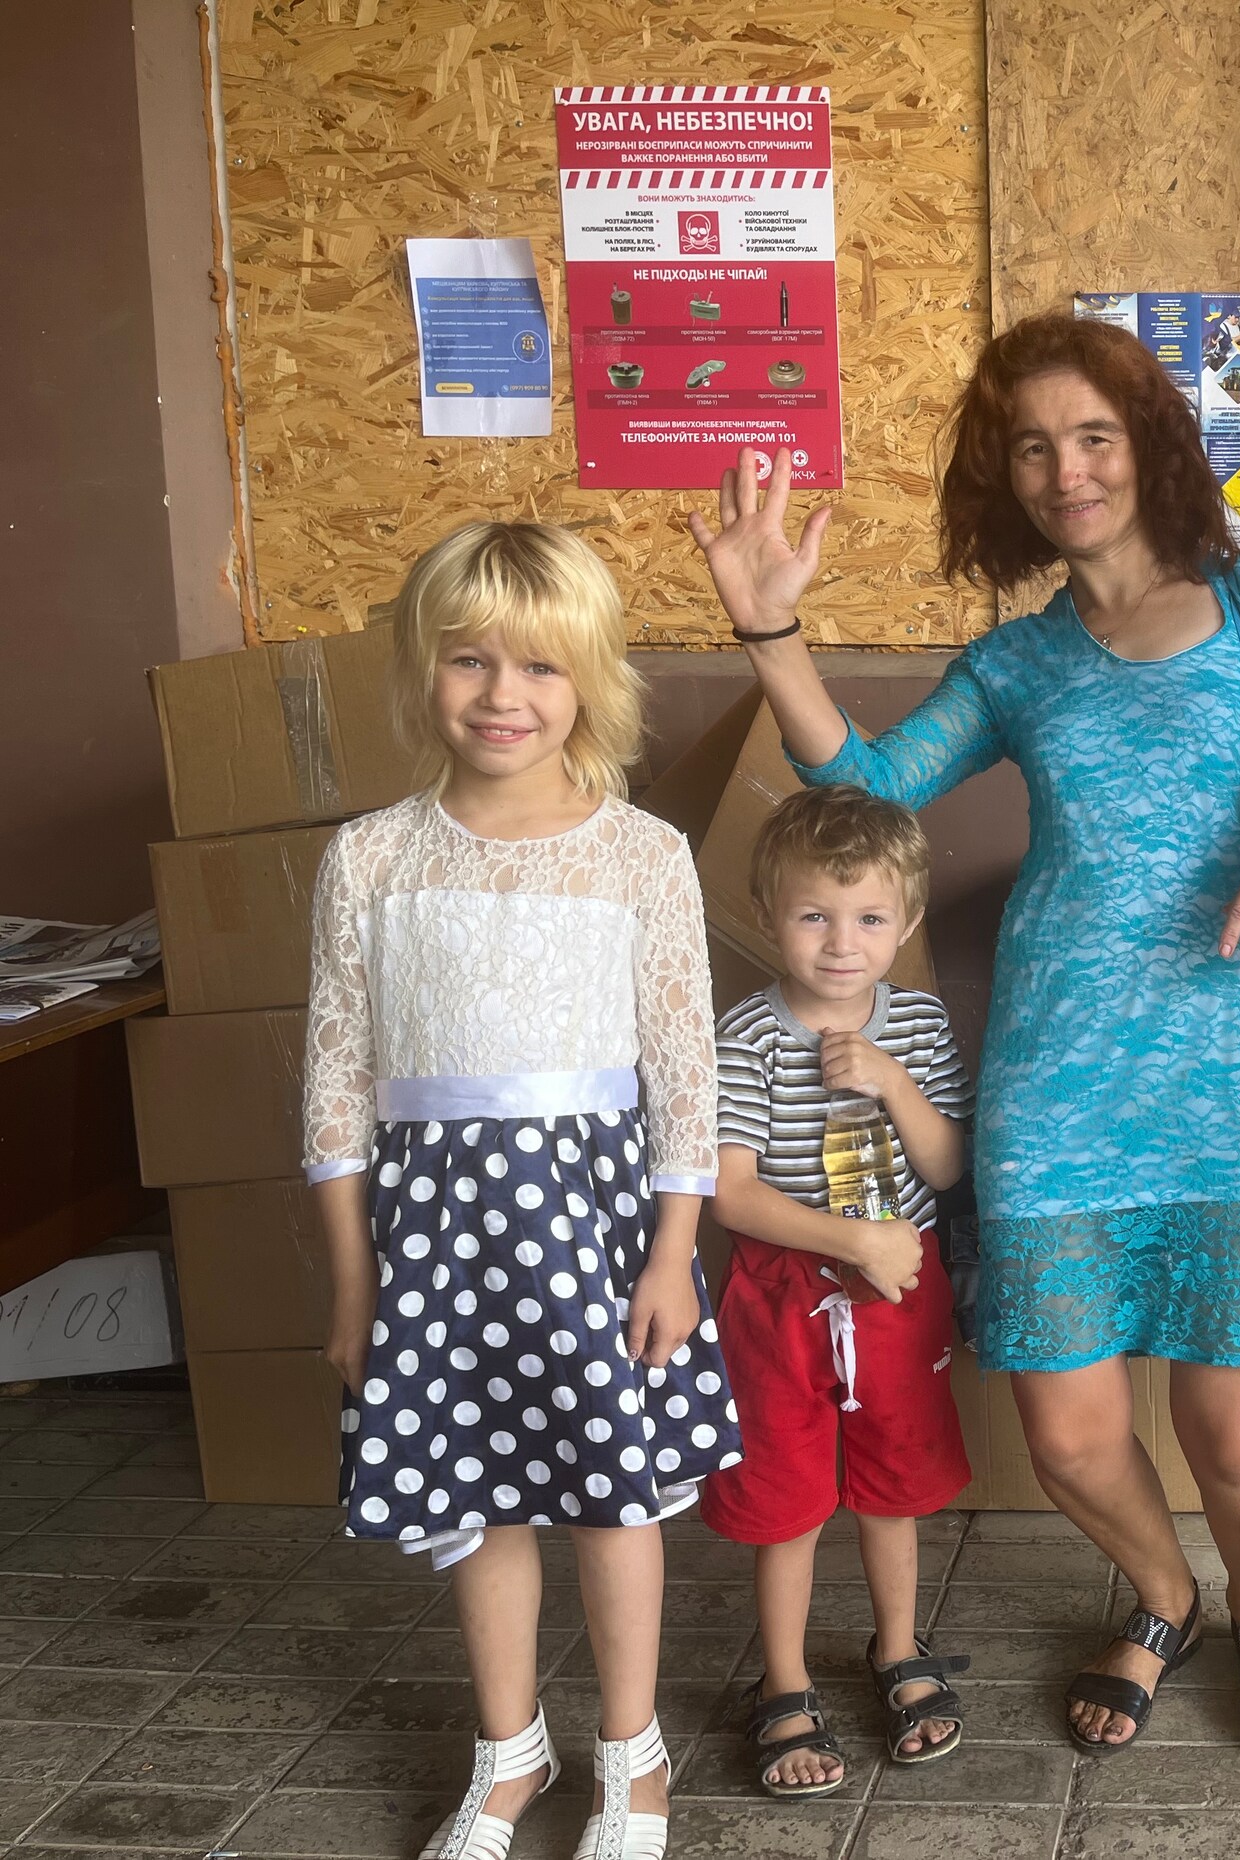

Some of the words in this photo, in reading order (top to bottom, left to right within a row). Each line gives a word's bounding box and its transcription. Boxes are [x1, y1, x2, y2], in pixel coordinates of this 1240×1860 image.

[573, 112, 651, 134] УВАГА,
[657, 111, 813, 131] НЕБЕЗПЕЧНО!
[576, 141, 637, 151] НЕРОЗІРВАНІ
[638, 141, 703, 151] БОЄПРИПАСИ
[704, 141, 747, 151] МОЖУТЬ
[748, 140, 813, 150] СПРИЧИНИТИ
[621, 154, 654, 163] ВАЖКЕ
[655, 154, 713, 163] ПОРАНЕННЯ
[714, 154, 735, 163] АБО
[737, 153, 768, 163] ВБИТИ
[697, 195, 756, 203] ЗНАХОДИТИСЬ:
[763, 209, 789, 217] КИНУТОЇ
[633, 269, 649, 280] НЕ
[651, 268, 708, 282] ПІДХОДЬ!
[709, 269, 725, 280] НЕ
[727, 267, 768, 280] ЧІПАЙ!
[746, 421, 788, 430] ПРЕДМЕТИ,
[621, 431, 700, 444] ТЕЛЕФОНУЙТЕ
[702, 433, 716, 443] ЗА
[717, 433, 776, 443] НОМЕРОМ
[778, 433, 796, 443] 101
